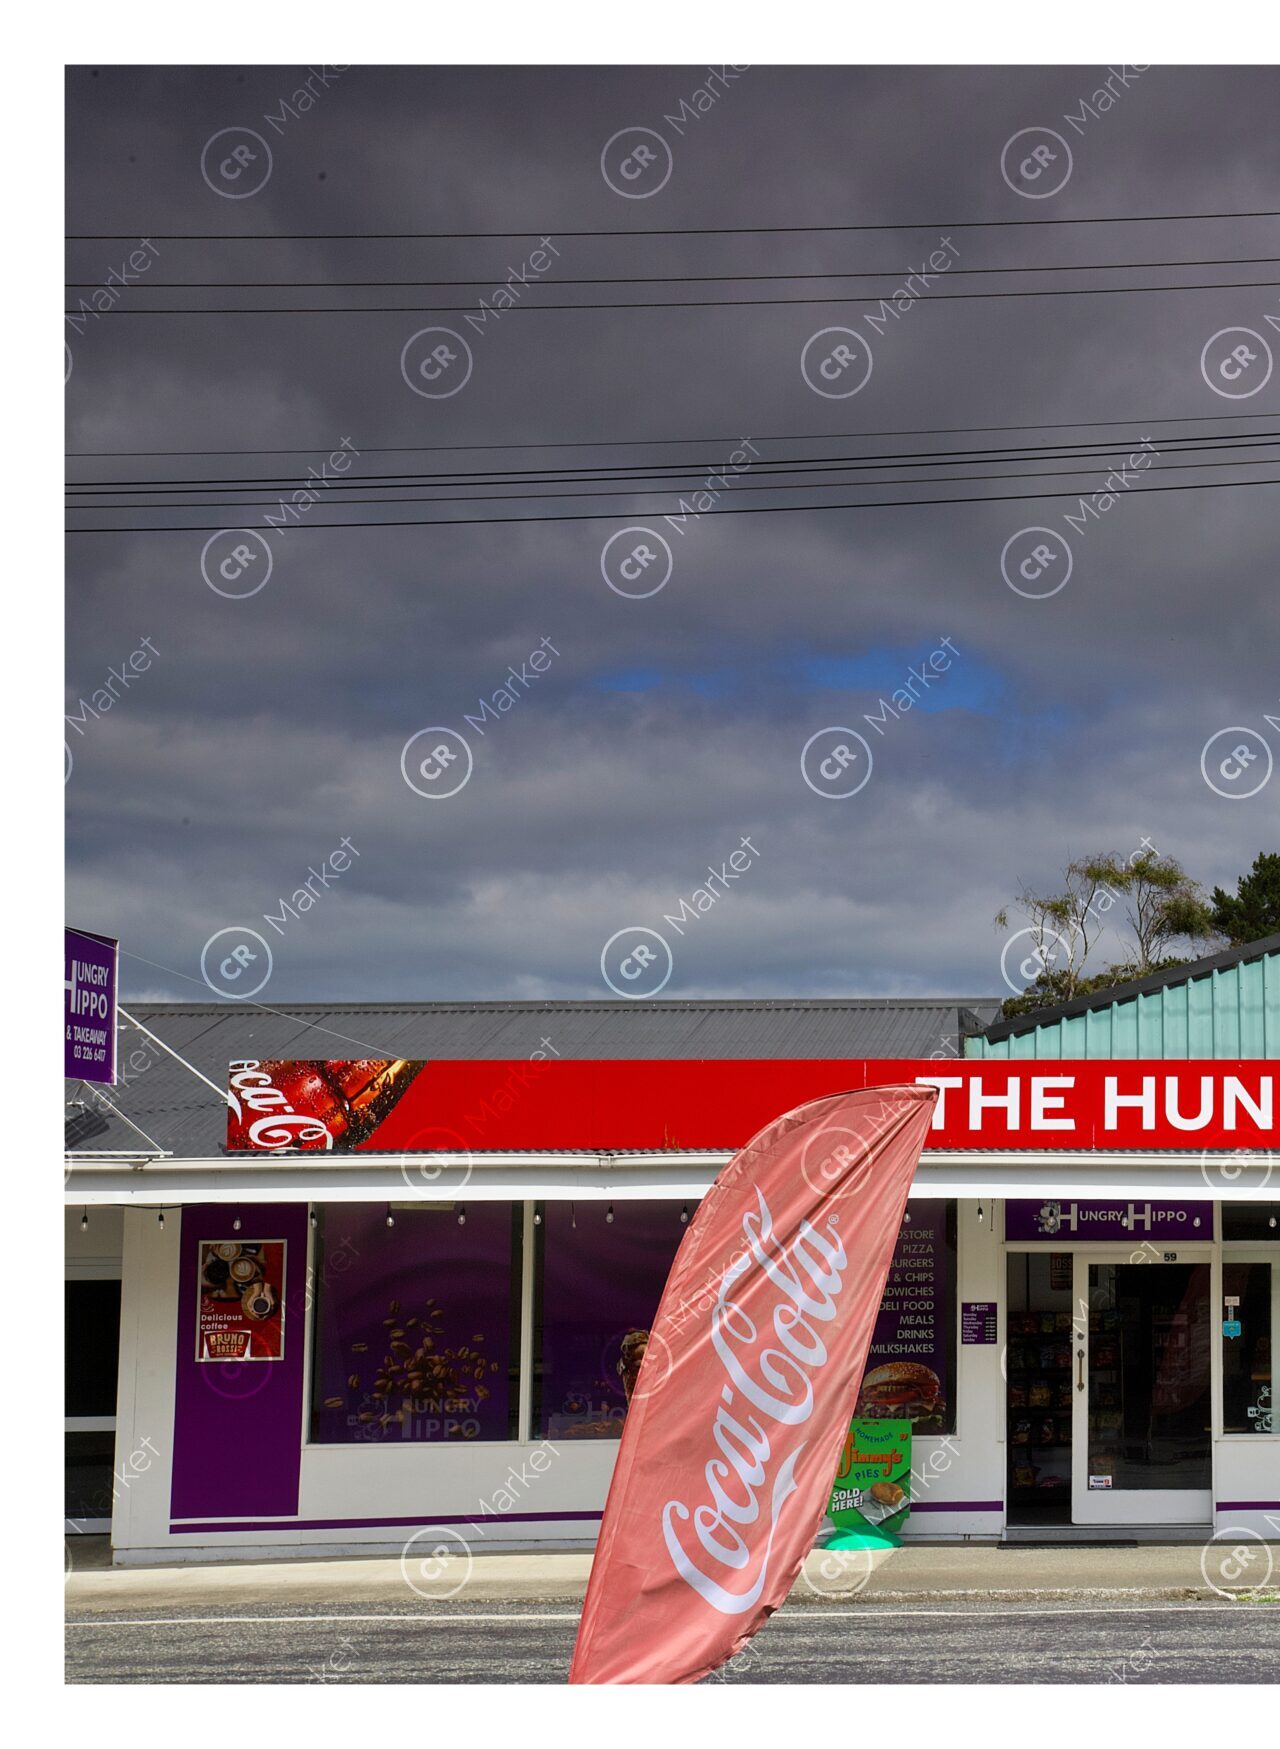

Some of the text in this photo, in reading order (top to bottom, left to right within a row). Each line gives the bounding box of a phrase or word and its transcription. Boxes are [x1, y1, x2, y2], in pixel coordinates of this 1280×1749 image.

[73, 1025, 107, 1046] TAKEAWAY
[73, 1045, 81, 1058] 03
[82, 1046, 93, 1060] 226
[914, 1076, 1075, 1130] THE
[1127, 1203, 1187, 1231] HIPPO
[902, 1244, 934, 1254] PIZZA
[1163, 1252, 1177, 1262] 59
[890, 1258, 934, 1268] BURGERS
[894, 1272, 902, 1282] &
[905, 1272, 934, 1282] CHIPS
[882, 1286, 934, 1296] NDWICHES
[879, 1301, 934, 1311] DELI FOOD
[201, 1313, 243, 1321] Delicious
[899, 1315, 934, 1325] MEALS
[200, 1322, 229, 1330] coffee
[897, 1329, 934, 1339] DRINKS
[870, 1344, 934, 1354] MILKSHAKES
[856, 1427, 894, 1443] HOMEMADE
[837, 1432, 903, 1478] Jimmy's
[854, 1468, 880, 1481] PIES
[832, 1487, 861, 1502] SOLD
[831, 1495, 864, 1512] HERE!
